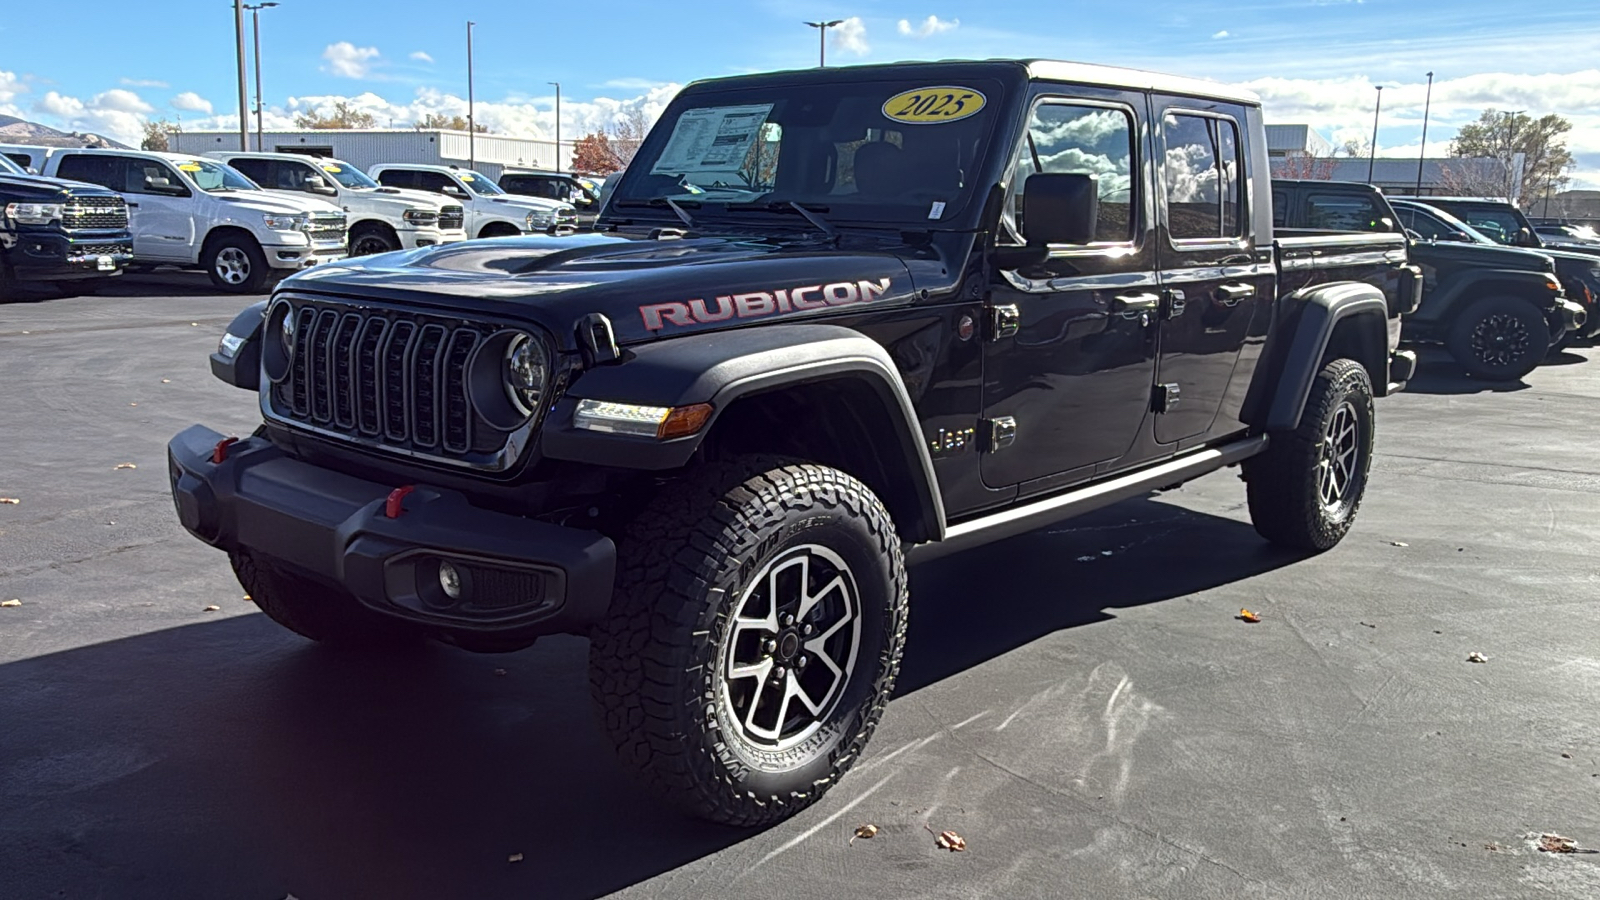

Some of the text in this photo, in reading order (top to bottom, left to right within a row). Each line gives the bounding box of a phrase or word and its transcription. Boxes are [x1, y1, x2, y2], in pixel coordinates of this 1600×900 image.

[895, 94, 973, 118] 2025
[639, 277, 891, 332] RUBICON
[931, 428, 975, 452] Jeep
